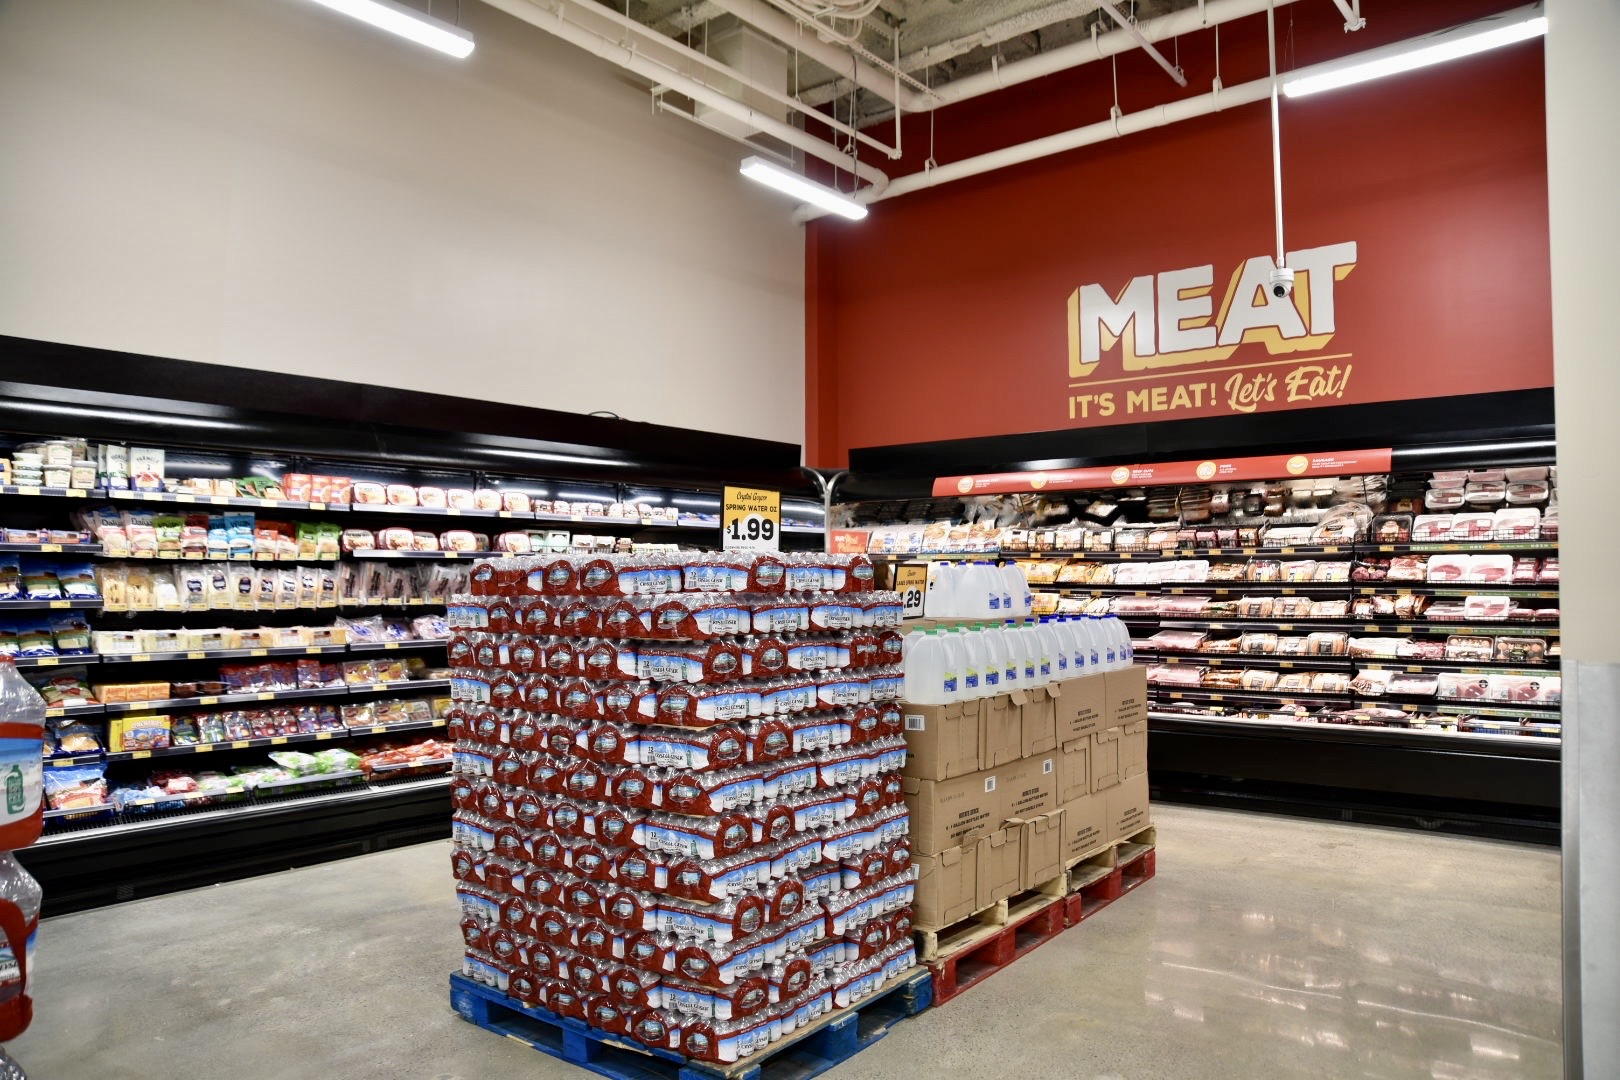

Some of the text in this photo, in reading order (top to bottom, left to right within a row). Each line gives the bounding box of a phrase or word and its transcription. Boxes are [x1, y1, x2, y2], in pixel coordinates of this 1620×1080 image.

[1068, 241, 1357, 377] MEAT
[1069, 364, 1353, 419] IT'S MEAT! Let's Eat!
[725, 503, 746, 511] SPRING
[748, 504, 768, 512] WATER
[726, 517, 774, 540] $1.99
